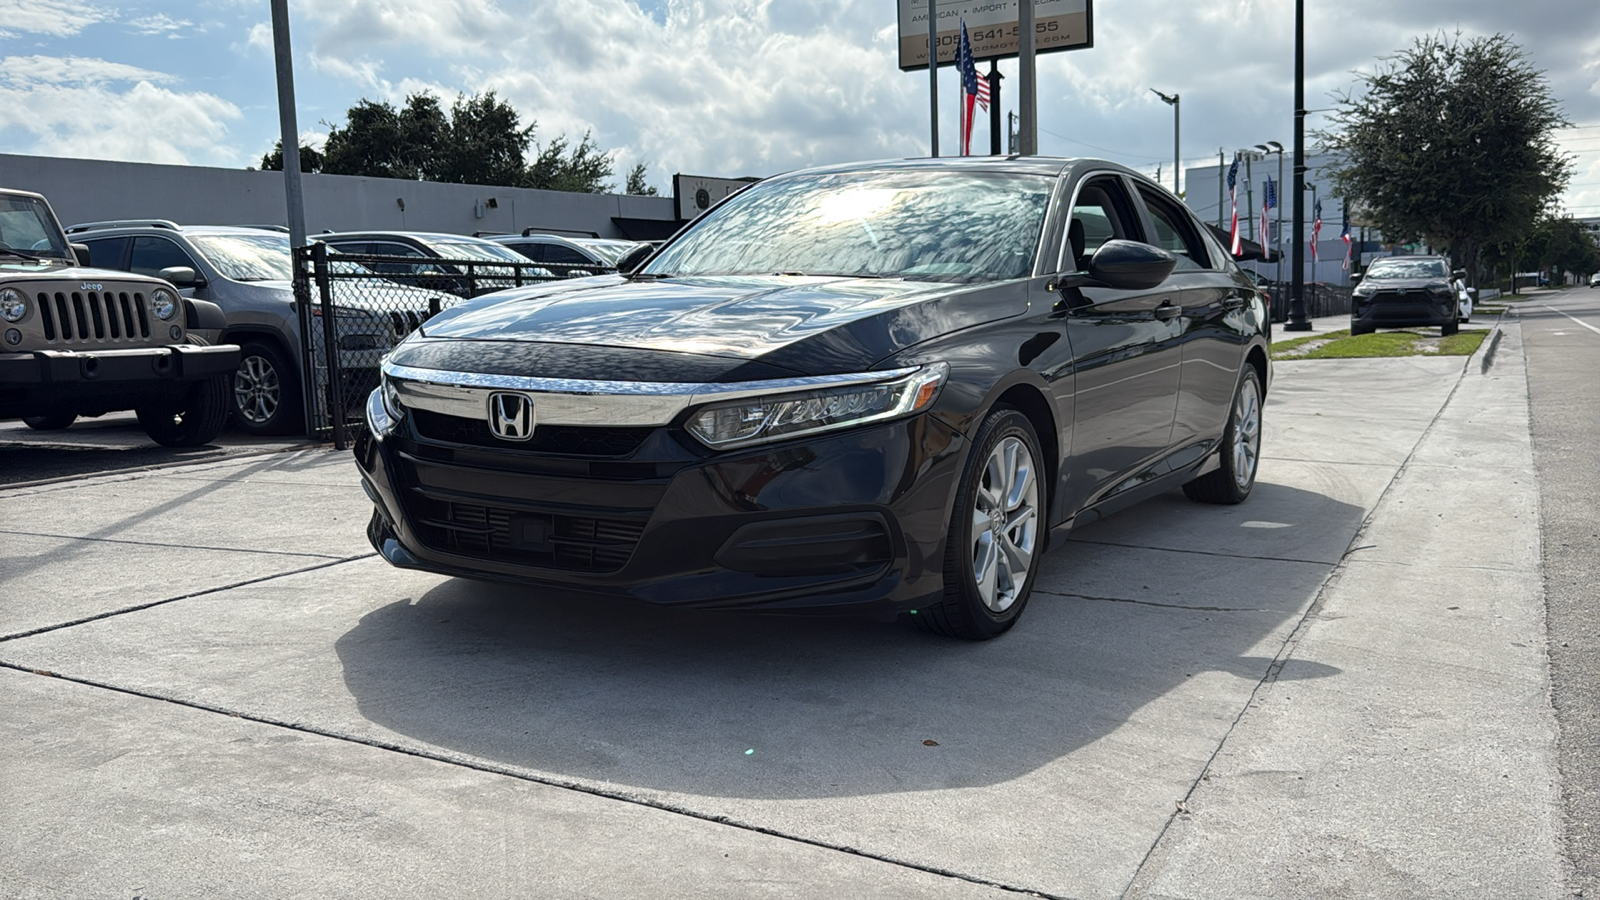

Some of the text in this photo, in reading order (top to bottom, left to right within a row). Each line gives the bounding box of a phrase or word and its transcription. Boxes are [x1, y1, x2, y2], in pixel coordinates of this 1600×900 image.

[972, 3, 1007, 13] IMPORT
[973, 21, 1059, 41] 541-555
[80, 282, 103, 291] Jeep
